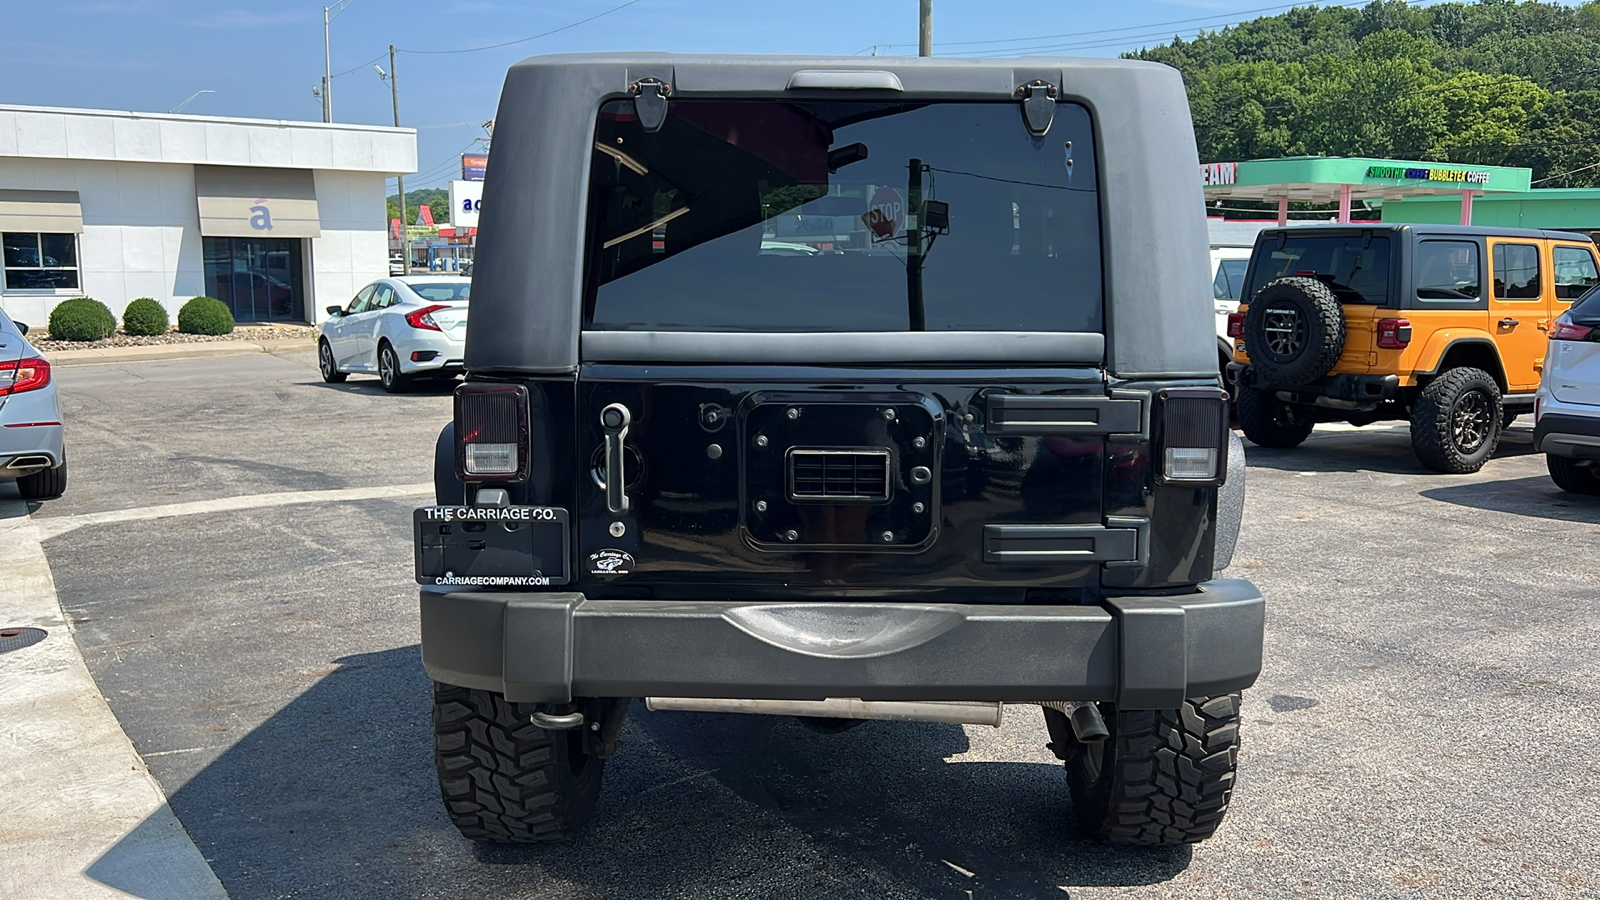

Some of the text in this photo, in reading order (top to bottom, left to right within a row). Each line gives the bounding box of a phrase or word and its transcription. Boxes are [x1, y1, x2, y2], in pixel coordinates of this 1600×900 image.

[1369, 166, 1406, 178] SMOOTHIE
[1407, 168, 1428, 179] CREPE
[1467, 171, 1490, 183] COFFEE
[871, 202, 901, 224] STOP
[424, 508, 557, 520] THE CARRIAGE CO.
[435, 577, 550, 586] CARRIAGECOMPANY.COM
